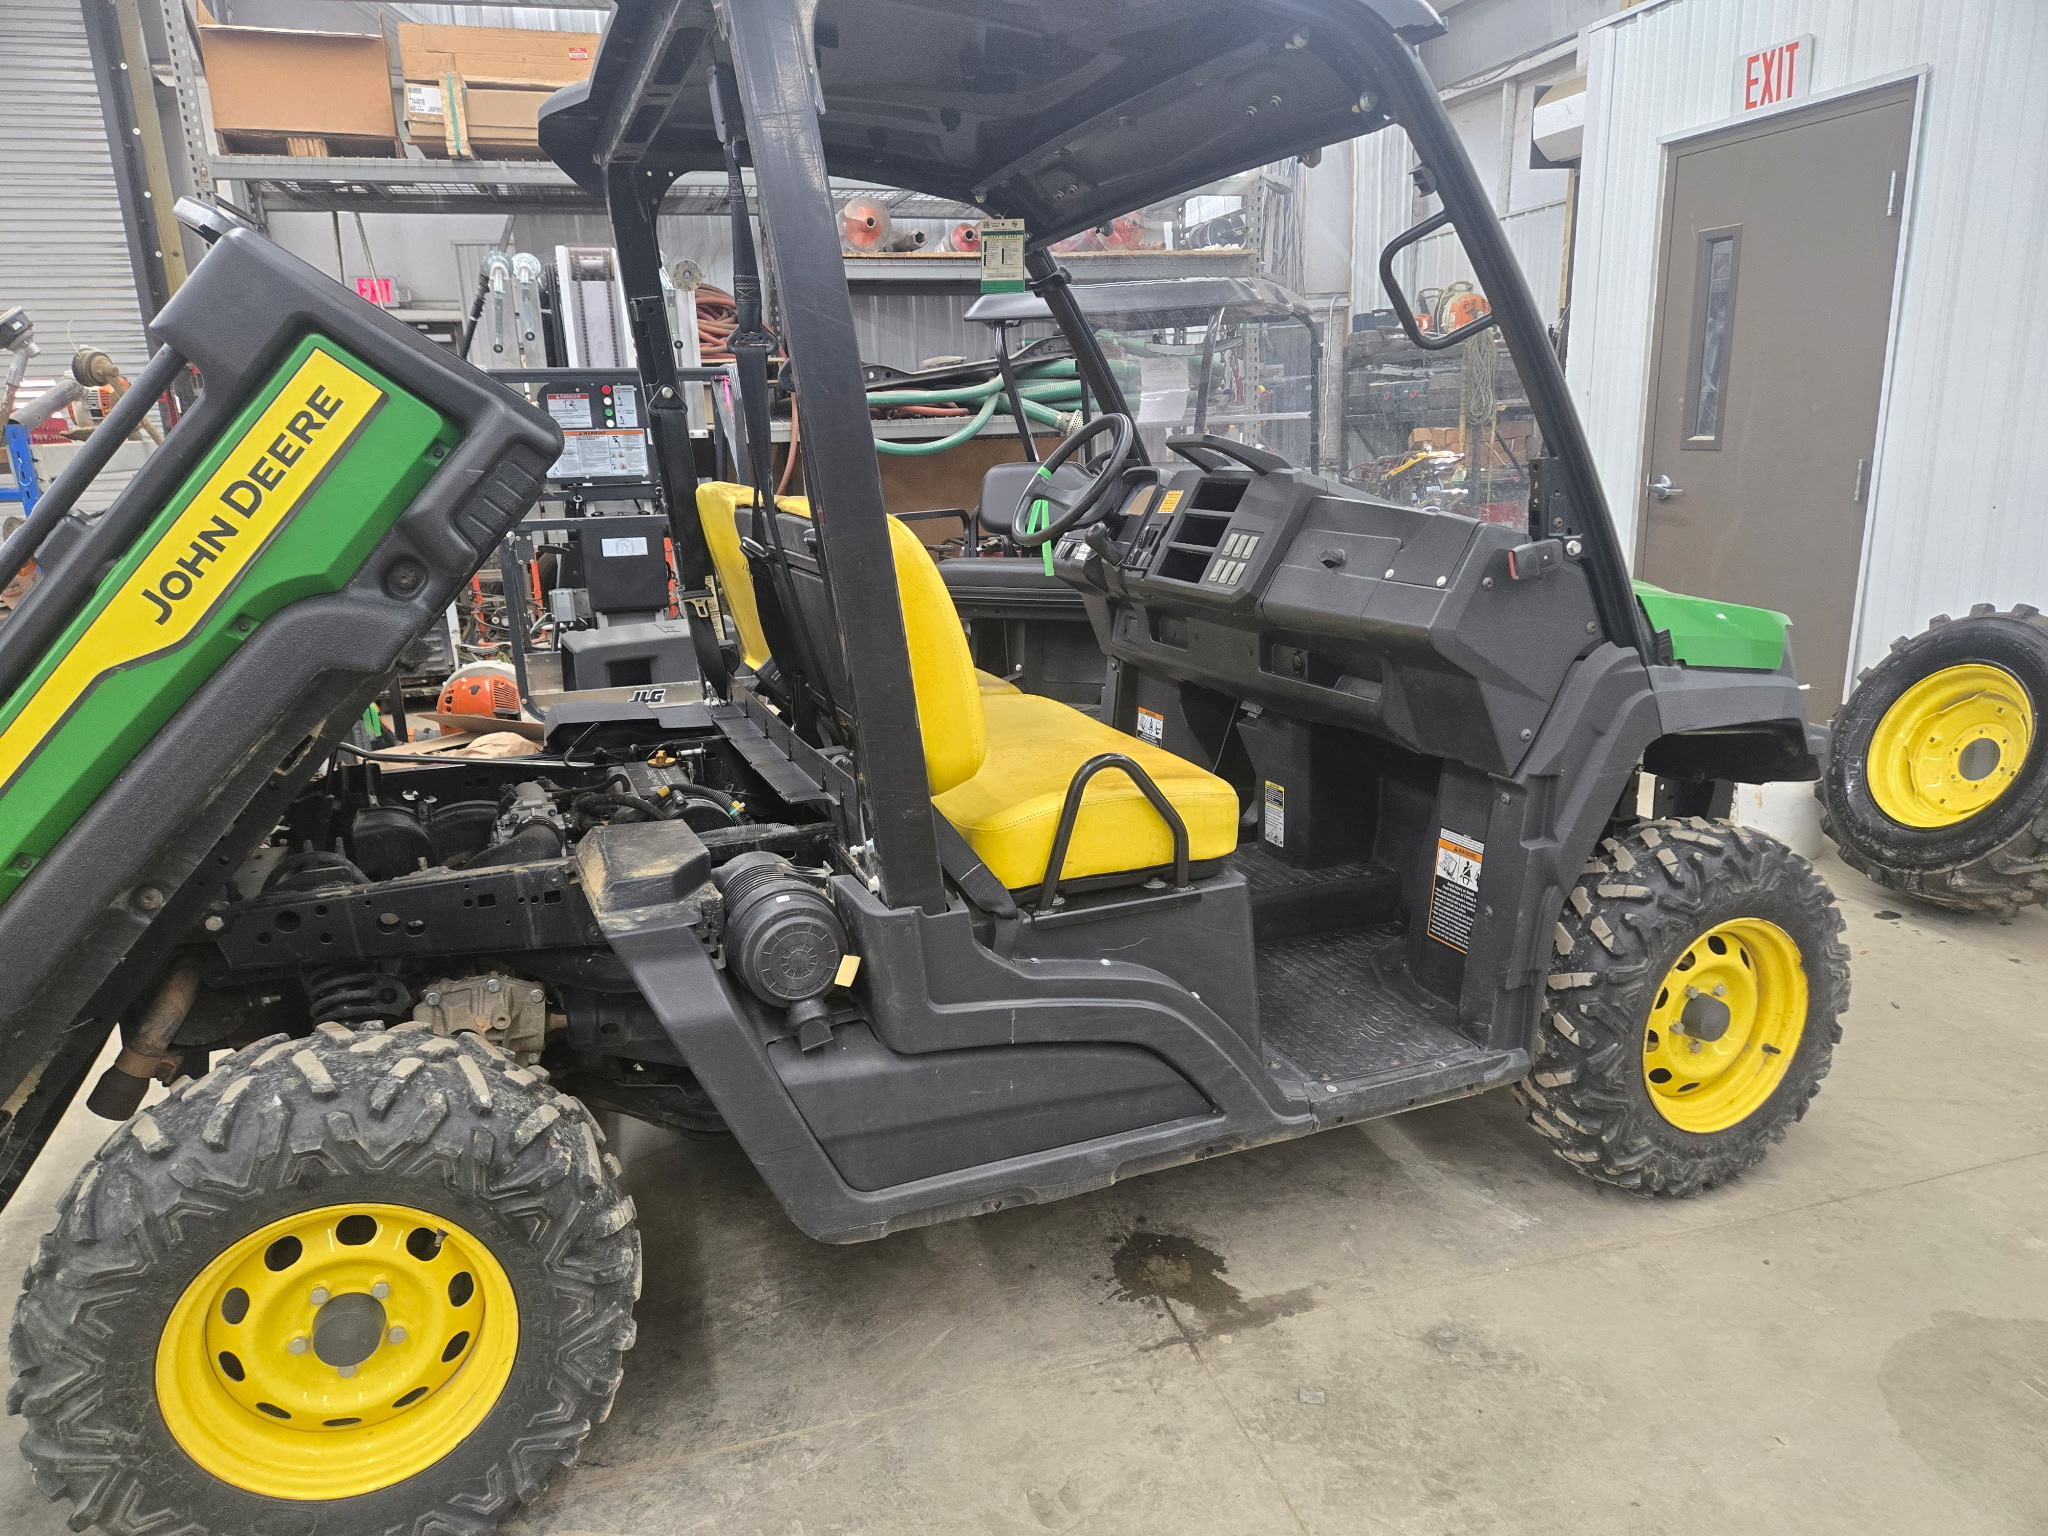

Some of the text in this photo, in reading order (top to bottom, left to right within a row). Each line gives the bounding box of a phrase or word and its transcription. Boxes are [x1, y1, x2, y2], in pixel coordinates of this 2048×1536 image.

[1745, 41, 1799, 110] EXIT
[141, 384, 344, 625] JOHN DEERE
[628, 689, 666, 704] JLG
